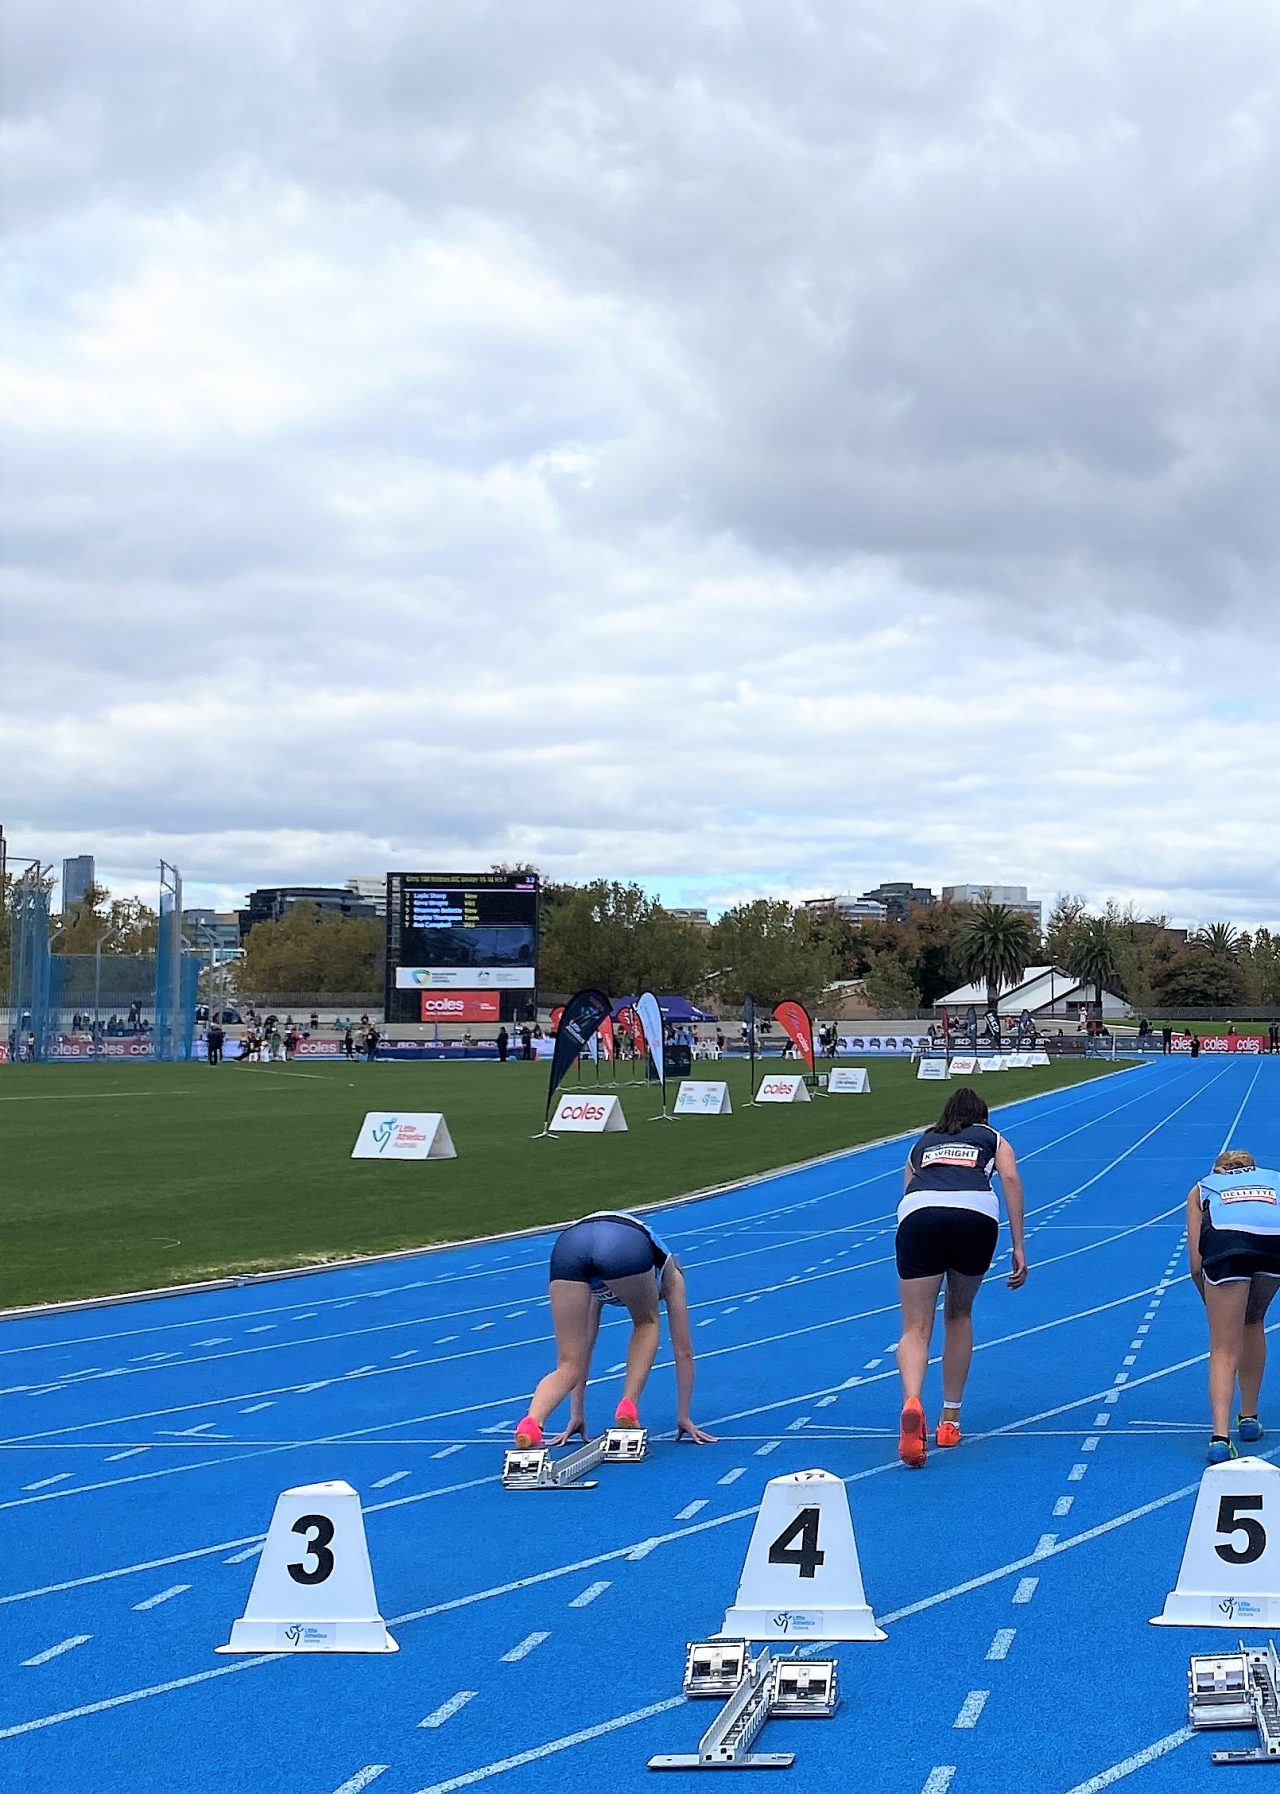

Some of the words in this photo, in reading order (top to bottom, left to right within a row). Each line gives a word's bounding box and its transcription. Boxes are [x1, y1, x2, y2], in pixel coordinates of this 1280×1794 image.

[426, 998, 464, 1010] coles
[300, 1042, 336, 1054] coles
[1203, 1036, 1228, 1051] coles
[1236, 1037, 1260, 1050] coles
[764, 1081, 793, 1094] coles
[561, 1102, 605, 1120] coles
[1214, 1495, 1266, 1564] 5
[287, 1514, 334, 1584] 3
[768, 1508, 824, 1578] 4
